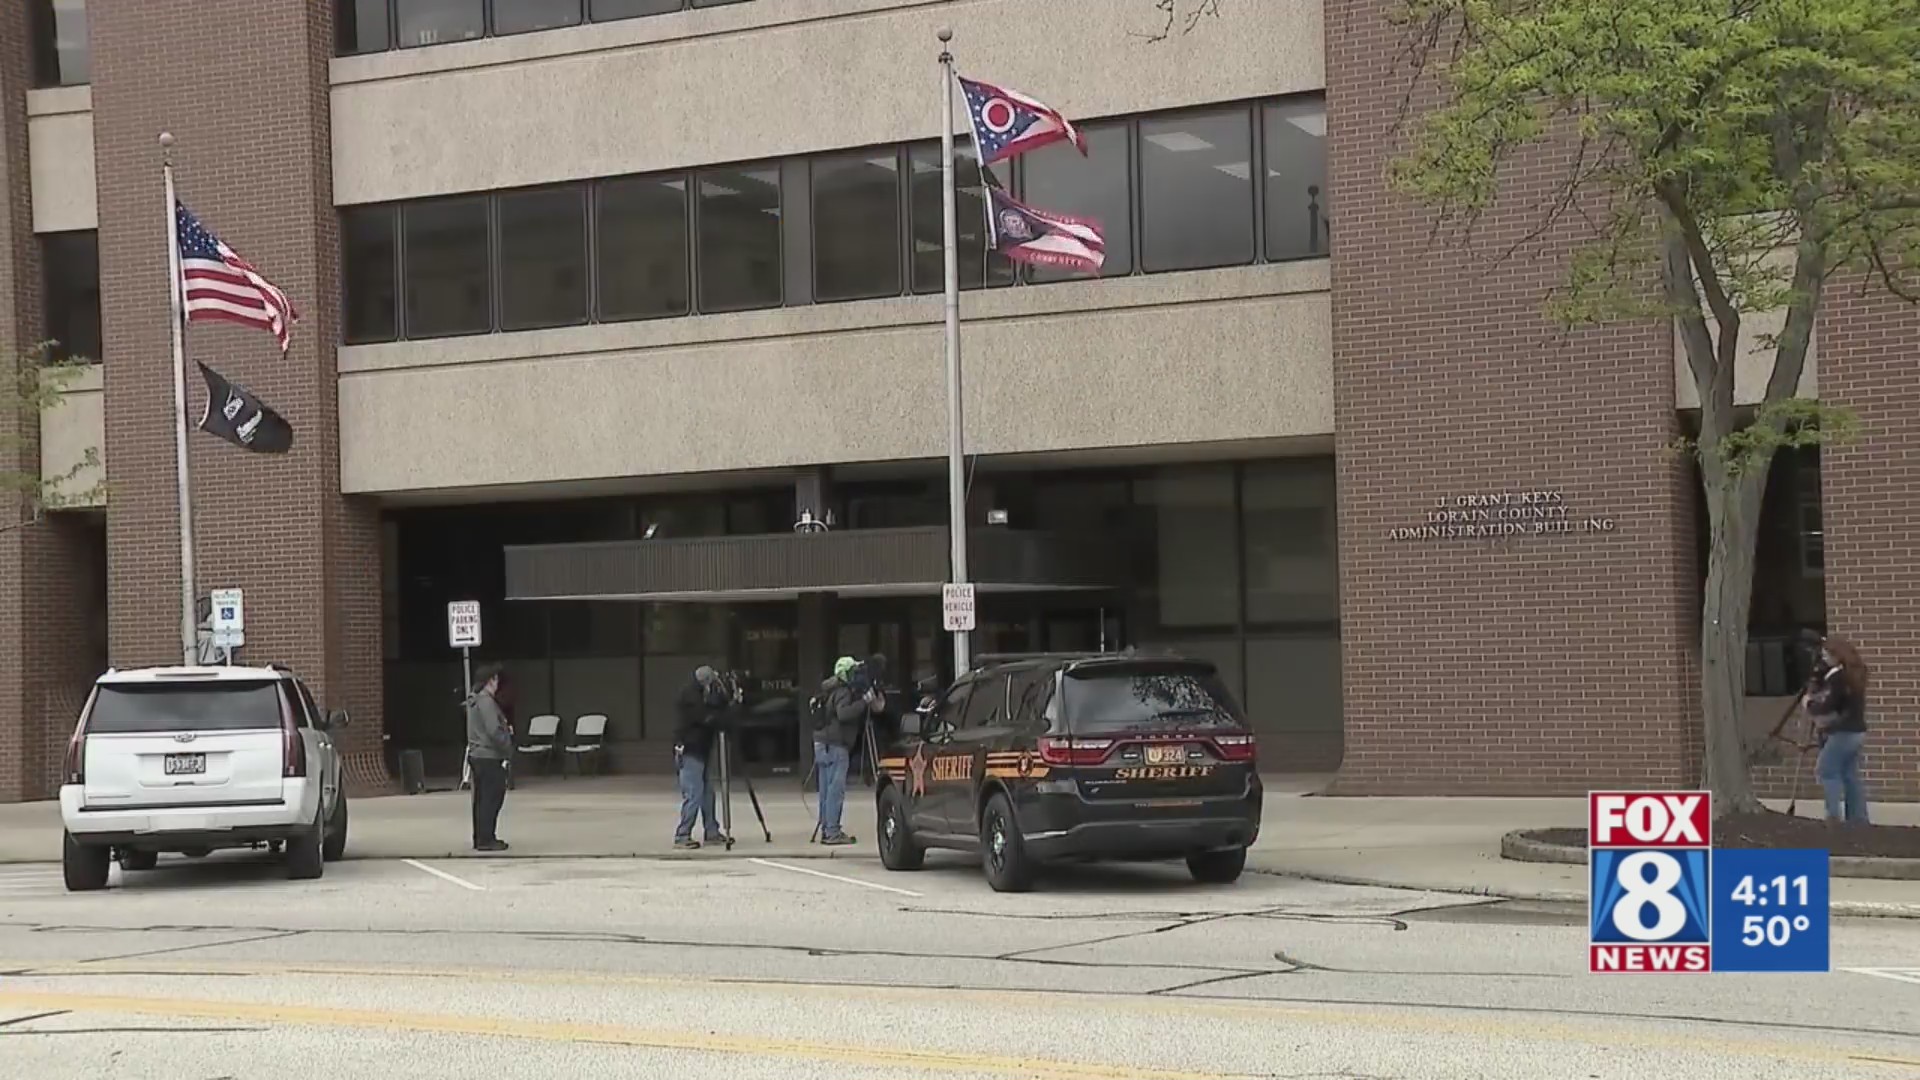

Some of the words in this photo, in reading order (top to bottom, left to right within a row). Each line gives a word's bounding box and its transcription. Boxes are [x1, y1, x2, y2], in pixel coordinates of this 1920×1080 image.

[1457, 493, 1511, 507] GRANT
[1522, 491, 1562, 504] KEYS
[1428, 508, 1490, 523] LORAIN
[1499, 506, 1568, 520] COUNTY
[1388, 523, 1527, 540] ADMINISTRATION
[945, 588, 972, 598] POLICE
[452, 605, 476, 613] POLICE
[944, 602, 973, 611] VEHICLE
[452, 615, 478, 624] PARKING
[949, 615, 968, 625] ONLY
[456, 625, 474, 634] ONLY
[761, 680, 793, 689] ENTER
[932, 755, 974, 781] SHERIFF
[1115, 766, 1213, 780] SHERIFF
